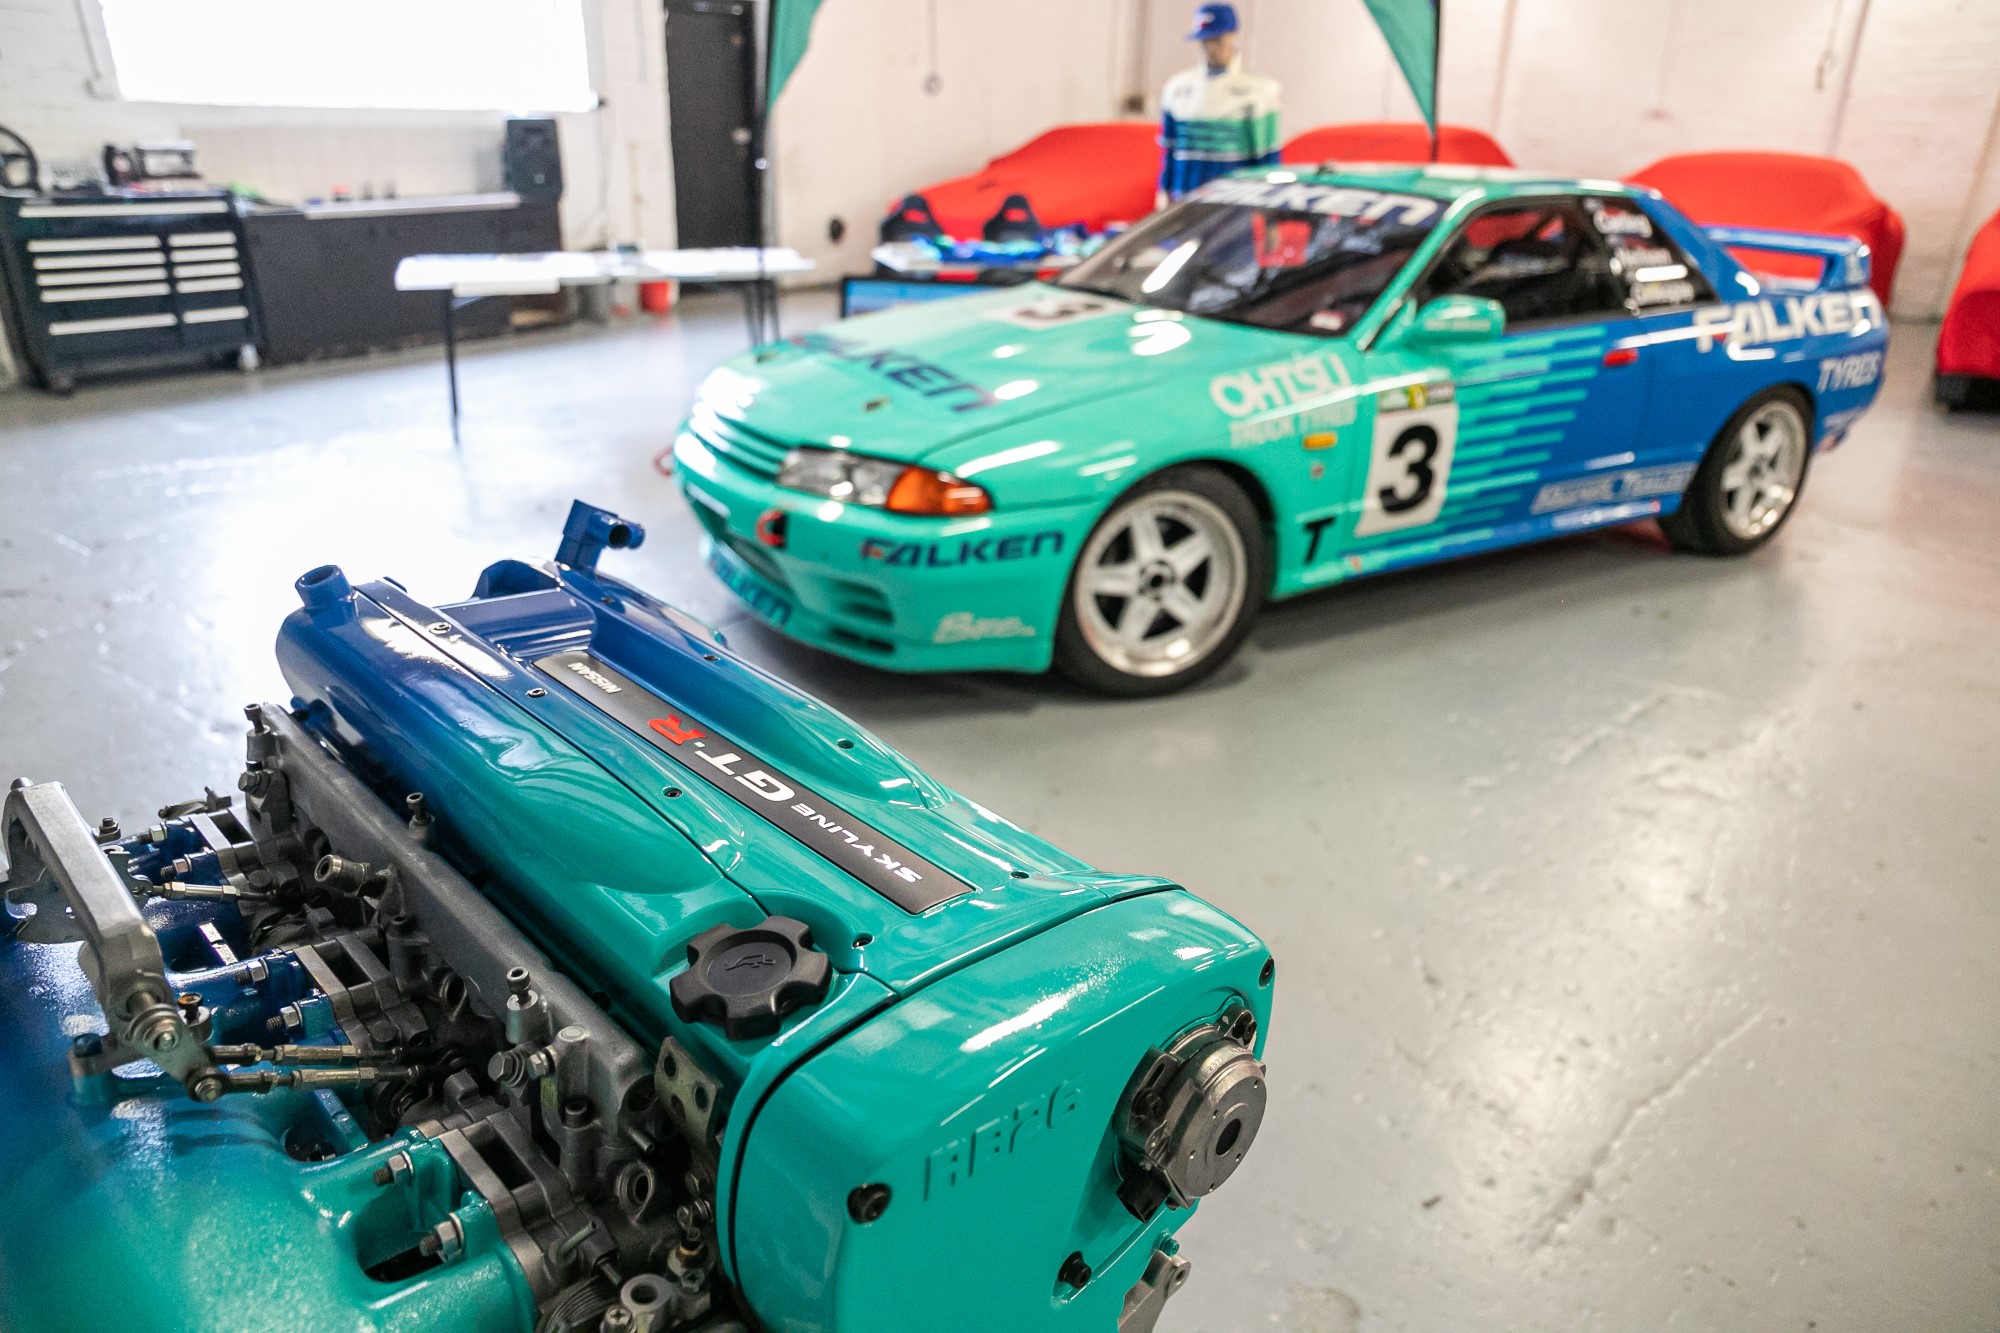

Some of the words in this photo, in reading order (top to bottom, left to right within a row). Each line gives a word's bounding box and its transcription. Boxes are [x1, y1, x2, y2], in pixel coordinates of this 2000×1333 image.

[1692, 290, 1882, 354] FALKEN
[1208, 351, 1352, 419] OHTSU
[1815, 351, 1882, 393] TYRES
[1378, 423, 1440, 515] 3
[859, 529, 1065, 569] FALKEN
[1303, 515, 1337, 567] T
[567, 661, 623, 694] NISSAN
[647, 713, 797, 802] GT-R
[790, 802, 924, 884] SKYLINE
[922, 1073, 1084, 1203] RB26
